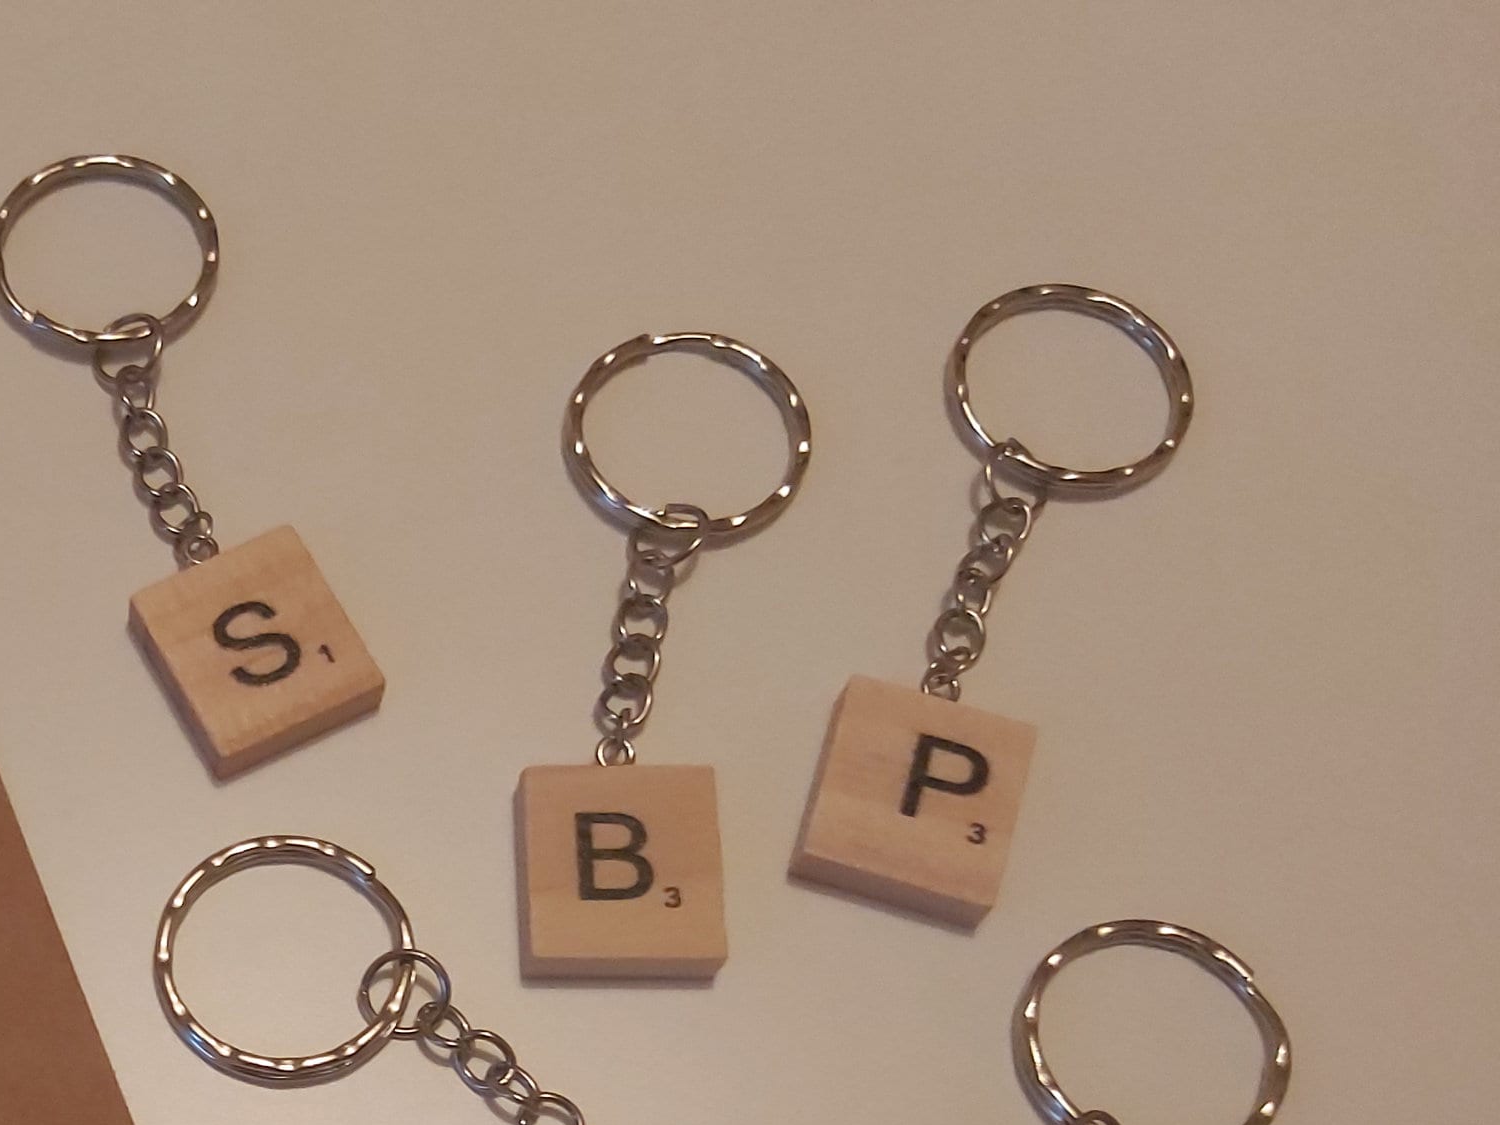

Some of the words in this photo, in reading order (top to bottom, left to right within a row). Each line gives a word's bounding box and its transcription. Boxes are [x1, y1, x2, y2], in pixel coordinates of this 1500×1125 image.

[211, 600, 302, 687] S
[317, 644, 336, 664] 1
[899, 732, 991, 818] P
[966, 822, 989, 845] 3
[574, 811, 656, 902] B
[663, 886, 682, 909] 3
